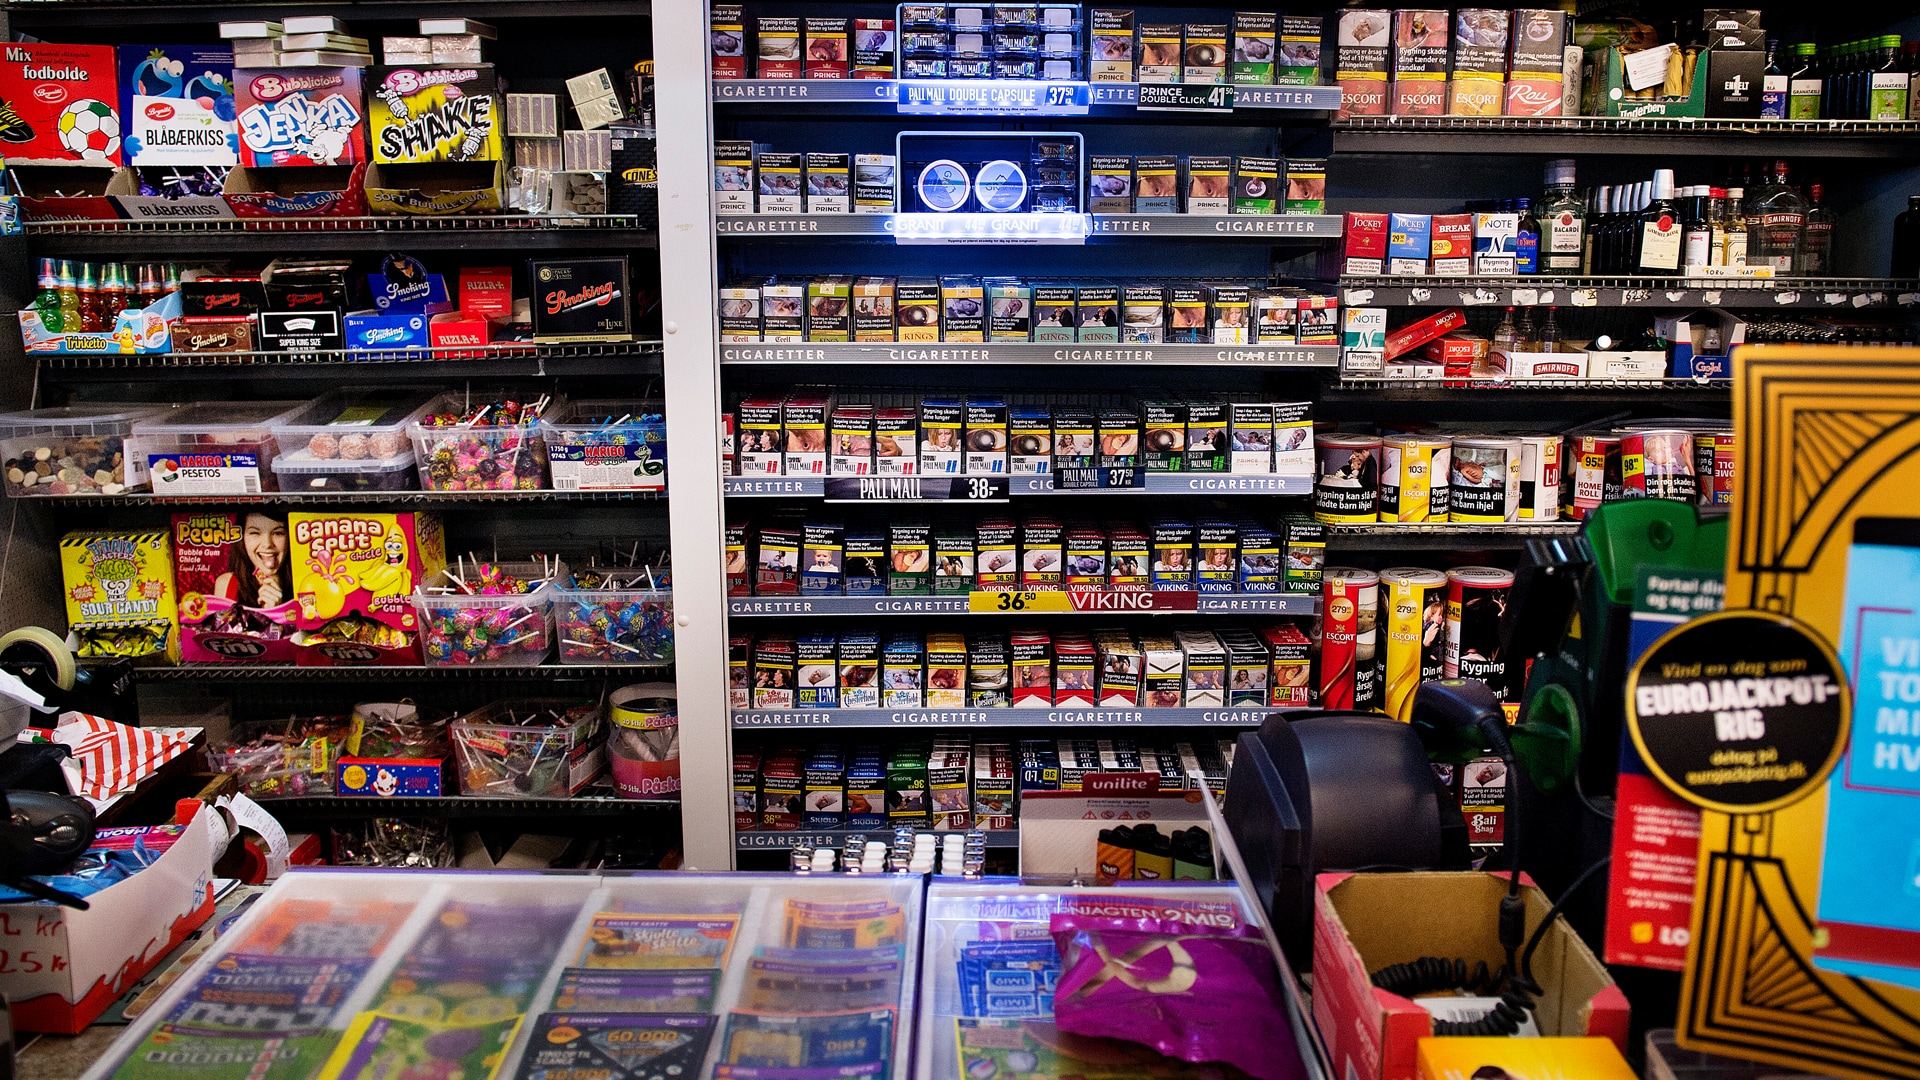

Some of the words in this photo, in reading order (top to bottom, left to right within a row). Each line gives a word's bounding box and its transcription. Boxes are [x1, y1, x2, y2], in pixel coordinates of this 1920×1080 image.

[6, 47, 33, 63] Mix
[23, 66, 88, 81] fodbolde
[257, 75, 341, 98] Bubblicious
[393, 69, 478, 94] Bubblicious
[711, 86, 808, 97] IGARETTER
[908, 88, 926, 101] PALL
[927, 88, 945, 101] MALL
[950, 89, 987, 101] DOUBLE
[992, 89, 1036, 102] CAPSULE
[1050, 87, 1064, 104] 37
[1140, 87, 1182, 96] PRINCE
[1208, 87, 1225, 106] 41
[1140, 96, 1174, 104] DOUBLE
[1179, 96, 1206, 104] CLICK
[1341, 94, 1382, 104] ESCORT
[1401, 94, 1442, 104] ESCORT
[1456, 93, 1498, 105] ESCORT
[242, 97, 352, 148] JENKA
[380, 94, 493, 158] SHAKE
[146, 126, 224, 146] BLÅBÆRKISS
[230, 193, 262, 205] SOFT
[267, 199, 314, 211] BUBBLE
[315, 192, 345, 207] GUM
[373, 192, 407, 203] SOFT
[409, 198, 456, 210] BUBBLE
[459, 193, 489, 206] GUM
[139, 202, 220, 217] BLÅBÆRKISS
[1353, 216, 1383, 228] JOCKEY
[1397, 217, 1426, 229] JOCKEY
[1485, 220, 1512, 229] NOTE
[1768, 214, 1802, 225] SMIRNOFF
[717, 221, 817, 231] CIGARETTER
[1215, 221, 1315, 231] CIGARETTER
[1438, 224, 1470, 233] BREAK
[386, 281, 431, 300] Smoking
[204, 292, 240, 310] Smoking
[286, 292, 324, 307] Smoking
[545, 281, 613, 314] Smoking
[1354, 315, 1381, 323] NOTE
[190, 332, 228, 351] Smoking
[366, 326, 404, 345] Smoking
[65, 336, 107, 350] Trinketto
[279, 339, 296, 347] SUPER
[298, 338, 309, 347] KING
[310, 338, 322, 346] SIZE
[725, 350, 825, 360] CIGARETTER
[890, 350, 989, 360] CIGARETTER
[1054, 351, 1152, 361] CIGARETTER
[1217, 352, 1315, 361] CIGARETTER
[584, 446, 625, 457] HARIBO
[179, 455, 223, 467] HARIBO
[1624, 460, 1635, 472] 98
[182, 469, 221, 477] PESETOS
[1063, 469, 1080, 481] PALL
[1081, 469, 1098, 481] MALL
[1110, 469, 1124, 486] 37
[1125, 469, 1133, 477] 50
[1189, 479, 1286, 489] CIGARETTER
[1578, 482, 1602, 491] HOME
[1647, 478, 1659, 486] Din
[1660, 479, 1672, 488] røg
[1673, 478, 1692, 486] skader
[1346, 491, 1360, 500] kan
[1361, 491, 1371, 499] slå
[1464, 491, 1478, 500] kan
[1479, 491, 1491, 500] slå
[1492, 492, 1503, 500] dit
[1579, 489, 1599, 498] ROLL
[1339, 501, 1357, 509] barn
[1358, 501, 1372, 511] ihjel
[1459, 501, 1475, 509] barn
[1476, 502, 1494, 511] ihjel
[178, 522, 242, 545] Pearls
[297, 519, 384, 543] Banana
[87, 540, 137, 555] BRAIN
[311, 533, 371, 557] Split
[349, 548, 382, 562] Chicle
[995, 574, 1014, 582] 36.50
[1041, 573, 1059, 581] 36.50
[1302, 571, 1321, 580] 36.50
[1201, 583, 1232, 591] VIKING
[1244, 583, 1276, 591] VIKING
[1289, 582, 1320, 590] VIKING
[374, 593, 411, 605] Bubble
[997, 592, 1025, 611] 36
[1024, 592, 1036, 600] 50
[1071, 592, 1153, 609] VIKING
[80, 602, 113, 616] SOUR
[116, 599, 158, 614] CANDY
[1396, 605, 1412, 613] 279
[1326, 632, 1355, 641] ESCORT
[1391, 632, 1420, 641] ESCORT
[210, 640, 259, 654] Fini
[1461, 660, 1505, 674] Rygning
[1662, 662, 1702, 678] Vind
[1704, 663, 1727, 675] en
[1769, 659, 1807, 673] som
[1636, 674, 1840, 716] EUROJACKPOT-
[1714, 709, 1765, 741] RIG
[1093, 778, 1148, 790] unilite
[1471, 814, 1496, 826] Bali
[1475, 824, 1493, 833] Shag
[739, 836, 834, 846] CIGARETTER
[607, 1030, 679, 1042] 60.000
